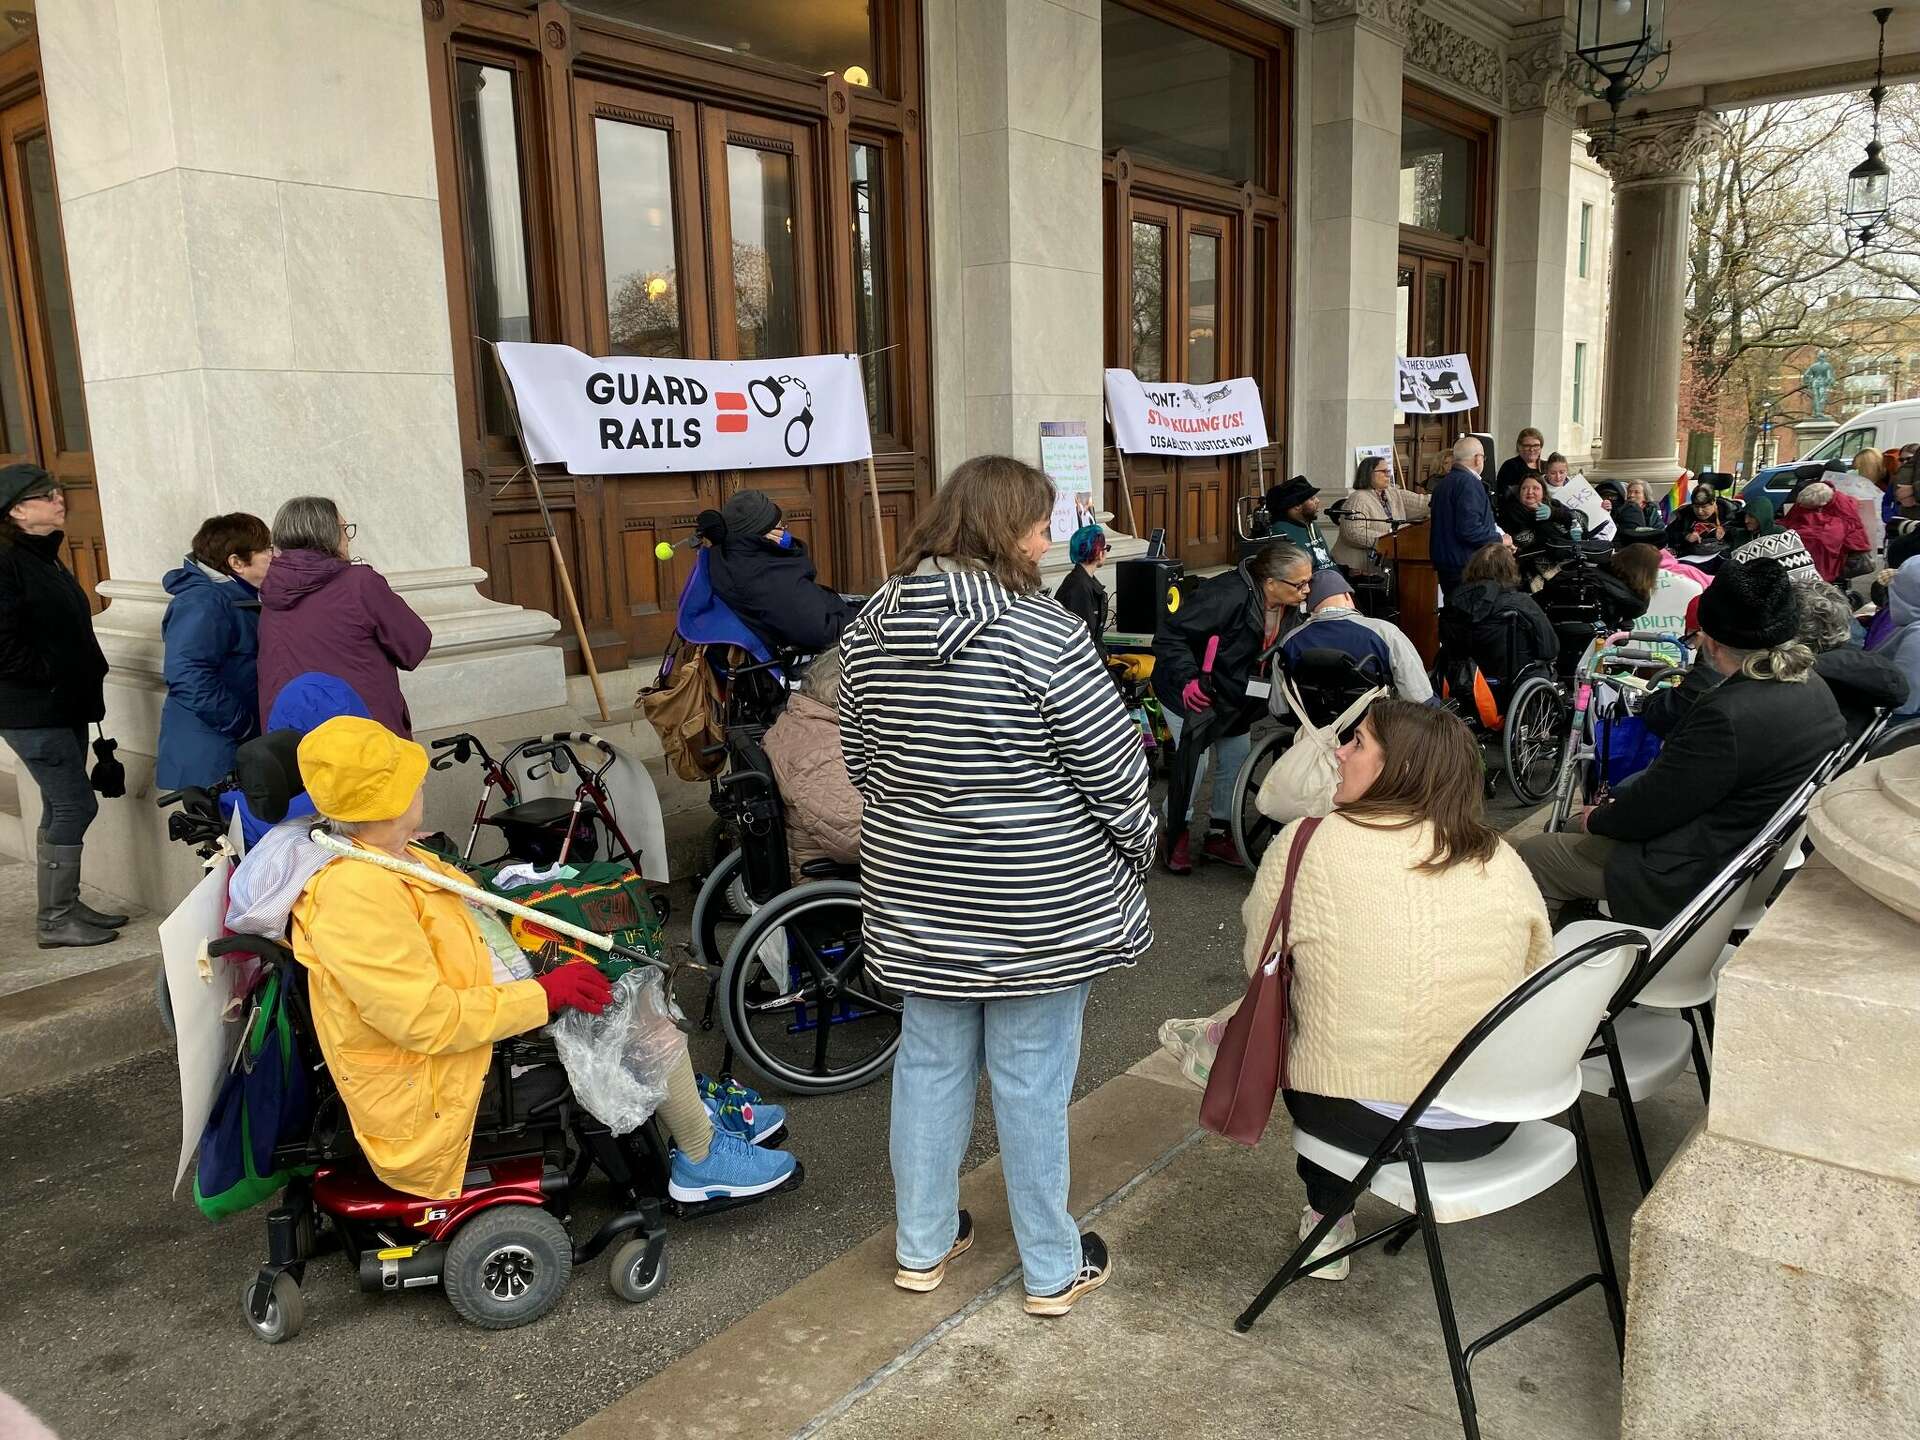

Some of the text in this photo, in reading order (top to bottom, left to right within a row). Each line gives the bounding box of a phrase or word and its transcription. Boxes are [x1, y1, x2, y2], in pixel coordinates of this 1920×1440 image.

[585, 372, 708, 406] GUARD
[1145, 392, 1180, 408] ONT:
[1170, 415, 1220, 433] KILLING
[1222, 410, 1245, 429] US!
[599, 417, 701, 450] RAILS
[1194, 438, 1229, 451] JUSTICE
[1229, 434, 1253, 448] NOW
